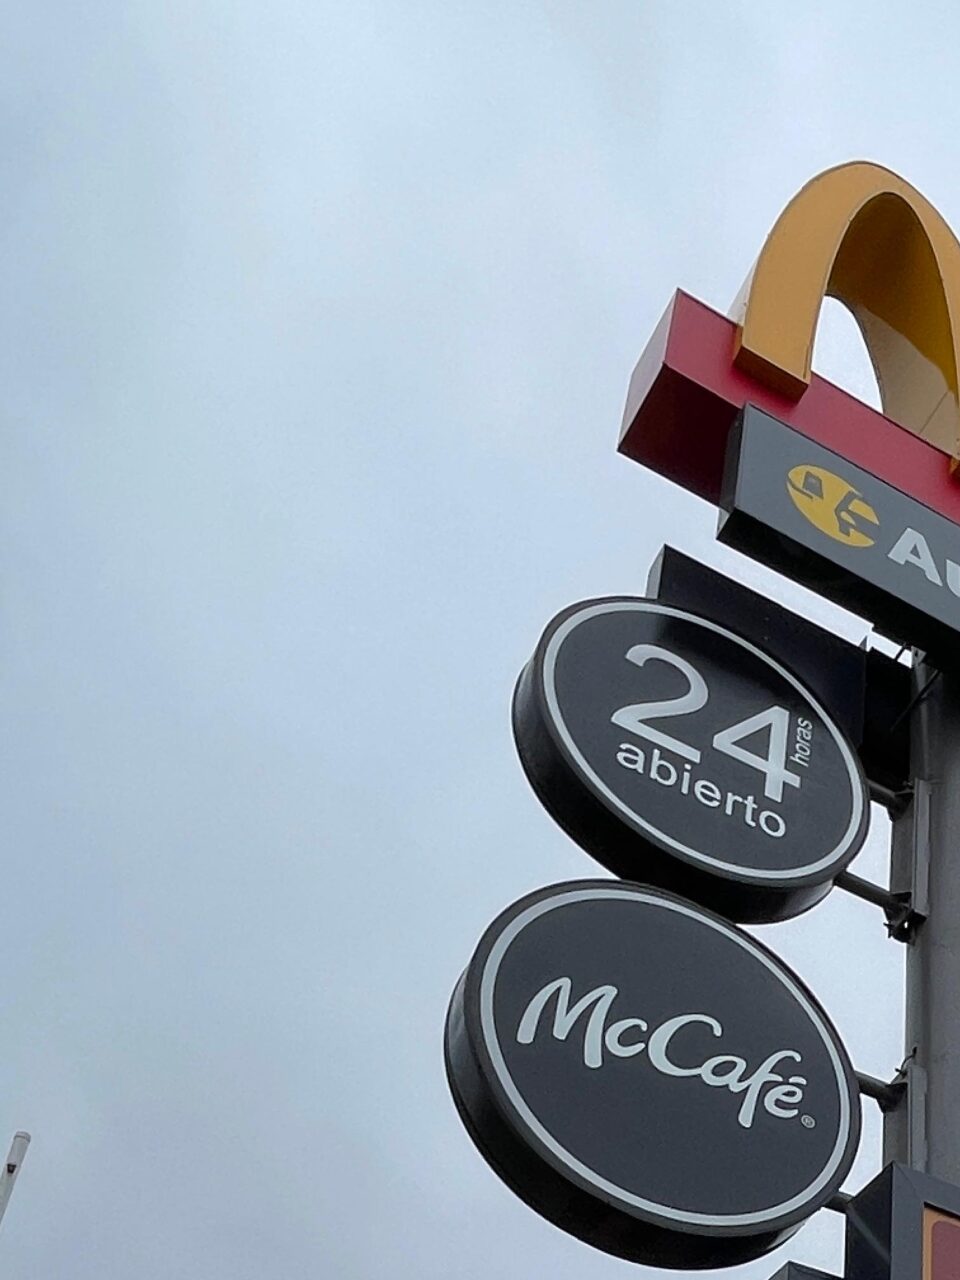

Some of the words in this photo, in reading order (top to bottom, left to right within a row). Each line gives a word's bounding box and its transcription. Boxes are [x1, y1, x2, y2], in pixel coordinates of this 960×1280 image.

[610, 643, 801, 803] 24
[789, 717, 813, 768] horas
[615, 742, 787, 838] abierto
